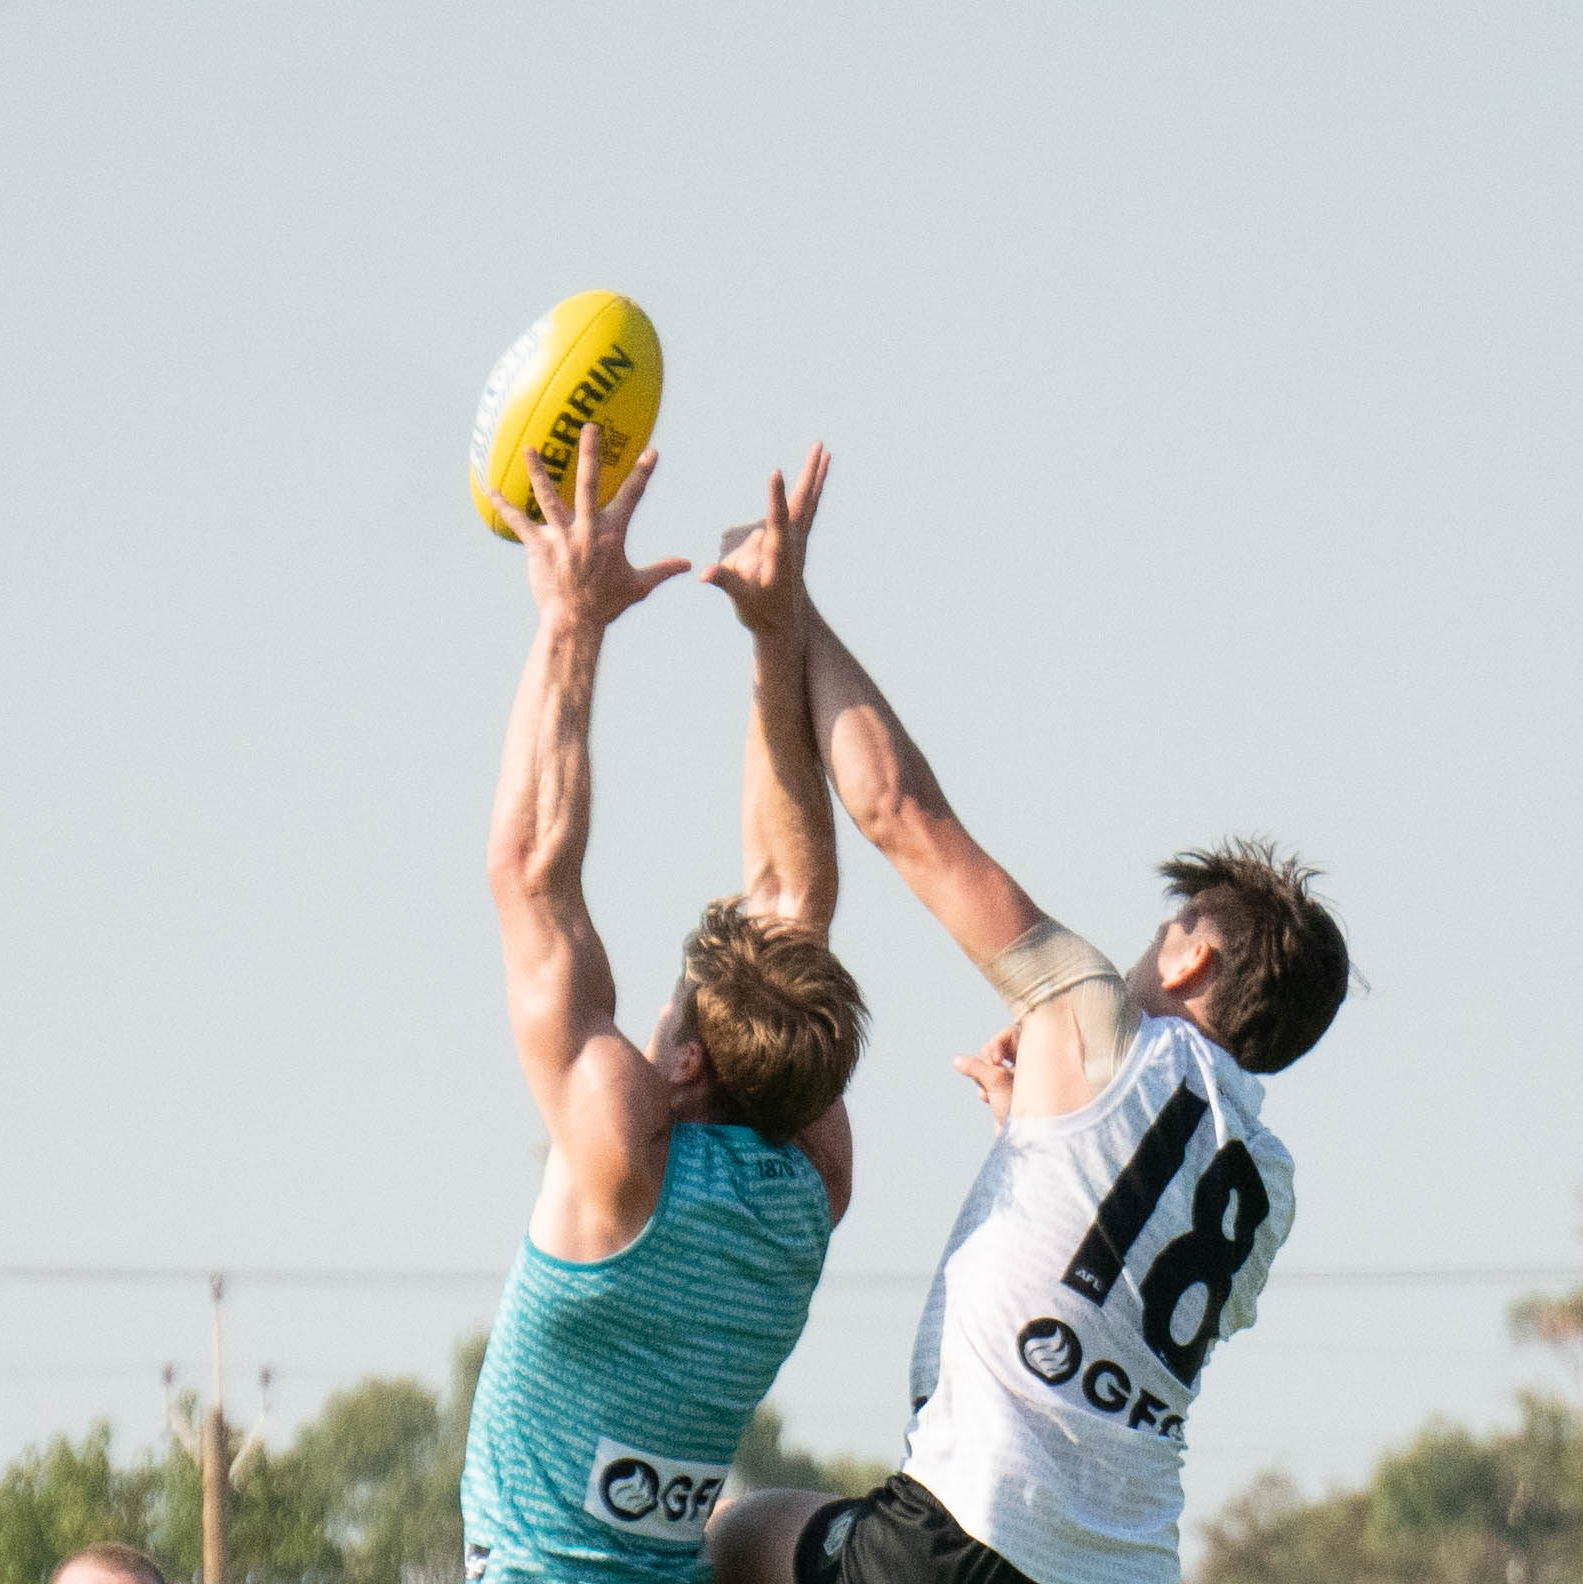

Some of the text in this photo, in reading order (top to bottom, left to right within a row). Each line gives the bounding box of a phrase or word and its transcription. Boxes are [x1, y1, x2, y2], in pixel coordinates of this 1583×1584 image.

[525, 343, 635, 522] ERRIN
[1062, 1076, 1270, 1388] 18
[661, 1474, 725, 1522] GF
